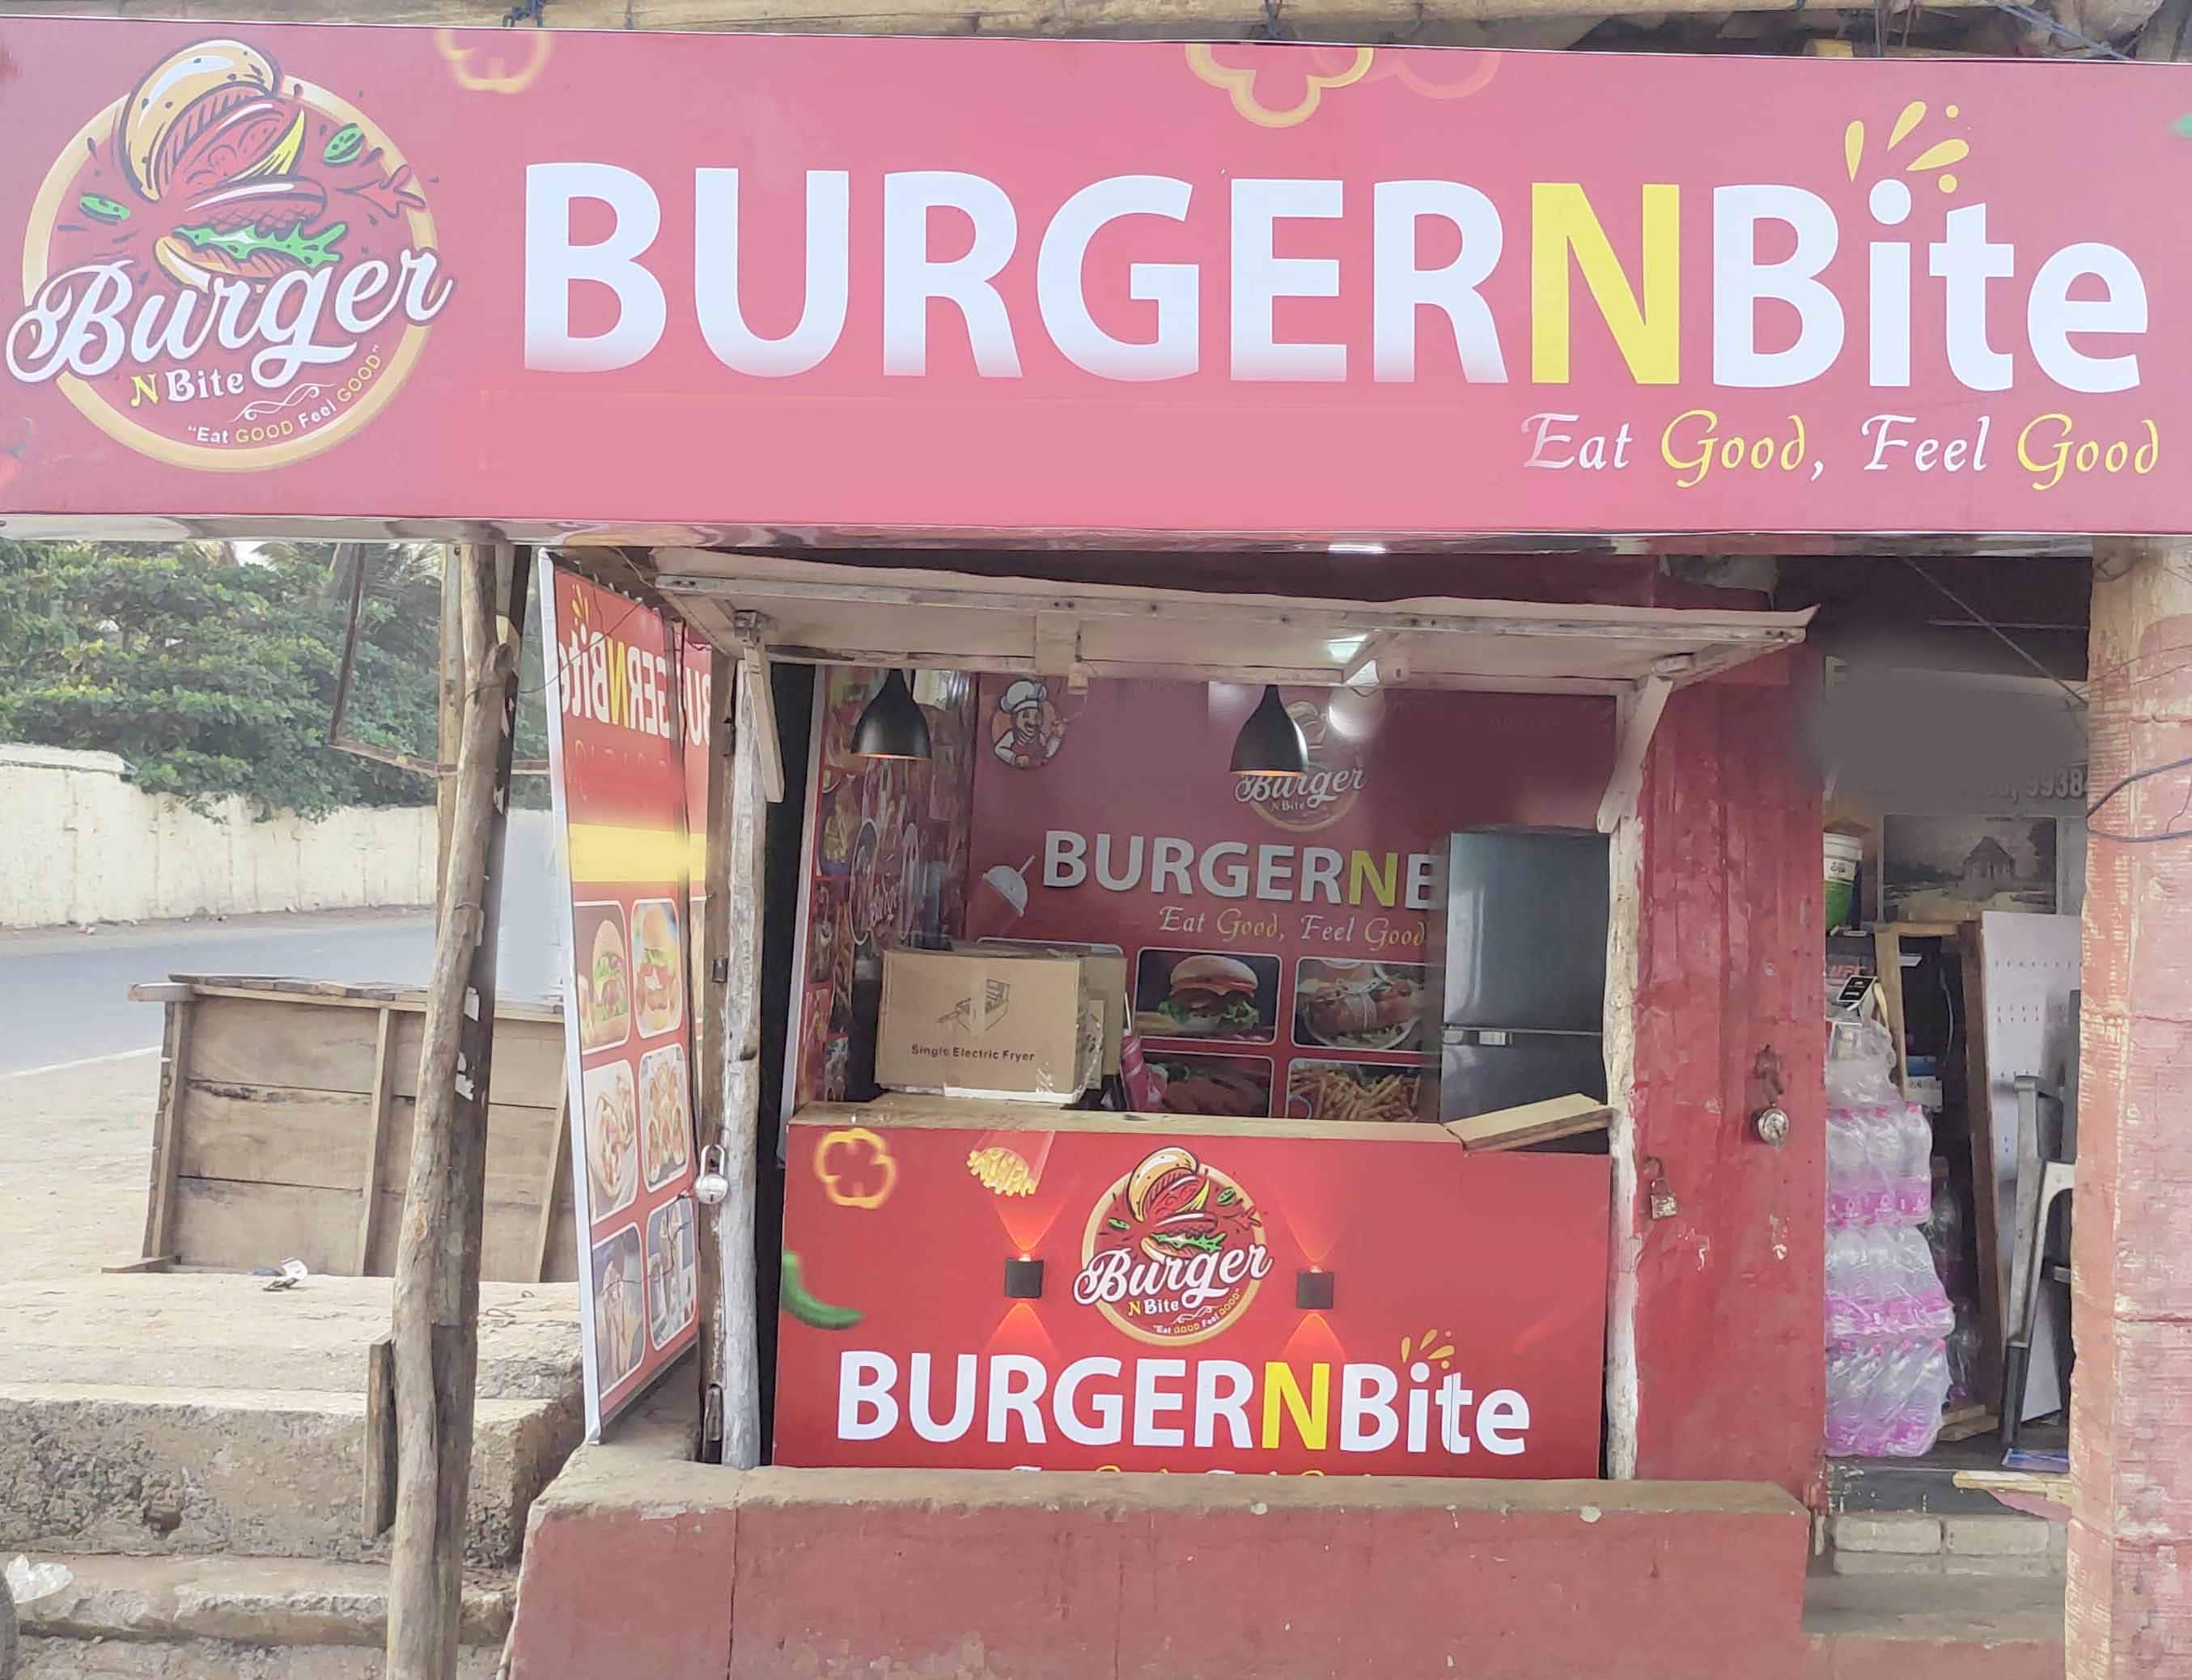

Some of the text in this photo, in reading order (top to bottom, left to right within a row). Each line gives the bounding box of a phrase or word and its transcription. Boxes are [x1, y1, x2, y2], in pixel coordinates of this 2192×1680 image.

[6, 248, 456, 388] Burger
[129, 368, 244, 407] N Bite
[235, 421, 294, 443] GOOD
[297, 400, 337, 428] Feel
[1521, 409, 2160, 490] Eat Good, Feel Good
[1235, 767, 1367, 808] Burger
[1159, 906, 1426, 952] Eat Good, Feel Good
[911, 1044, 1035, 1062] Single Electric Fryer
[1074, 1244, 1274, 1309] Burger
[1128, 1298, 1179, 1316] N Bite
